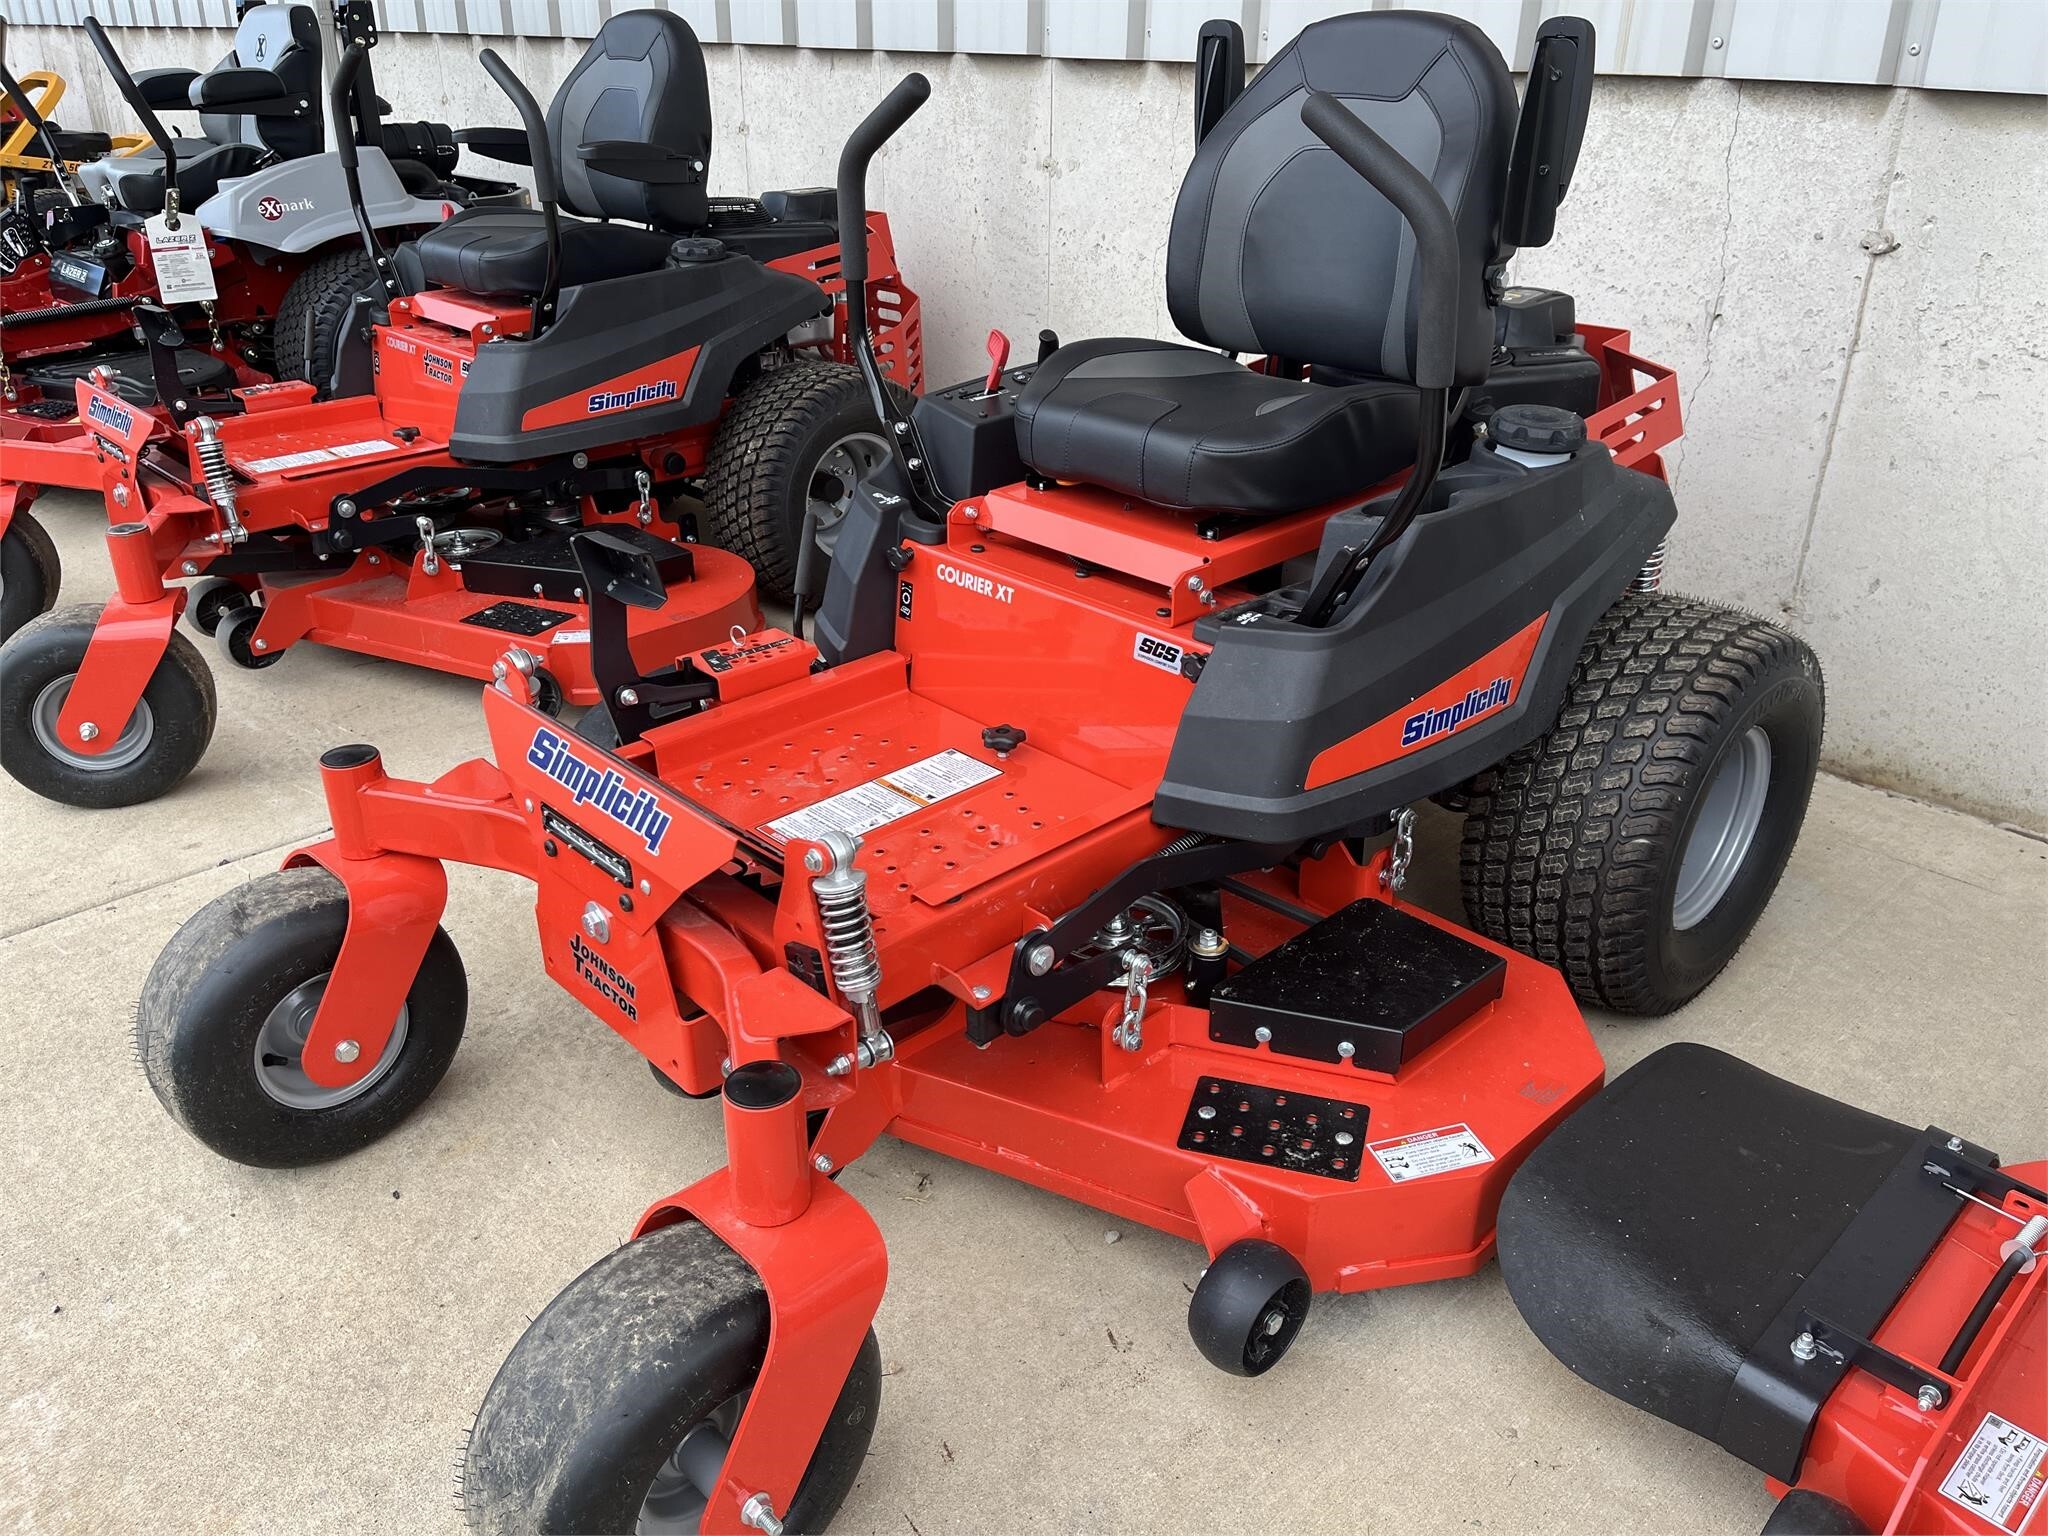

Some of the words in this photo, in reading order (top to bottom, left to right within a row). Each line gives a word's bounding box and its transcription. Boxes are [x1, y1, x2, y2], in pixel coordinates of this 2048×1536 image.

[257, 198, 315, 218] eXmark
[60, 262, 81, 281] LAZER
[80, 270, 89, 284] Z
[386, 336, 409, 353] COURIER
[408, 343, 417, 355] XT
[423, 348, 453, 370] JOHNSON
[424, 362, 453, 383] TRACTOR
[588, 379, 677, 413] Simplicity
[88, 393, 134, 440] Simplicity
[936, 563, 994, 597] COURIER
[994, 583, 1015, 605] XT
[1138, 637, 1180, 664] SCS
[1400, 676, 1514, 748] Simplicity
[527, 726, 672, 856] Simplicity
[569, 933, 635, 1000] JOHNSON
[573, 951, 637, 1021] TRACTOR
[1406, 1132, 1438, 1142] DANGER
[2020, 1476, 2043, 1508] DANGER
